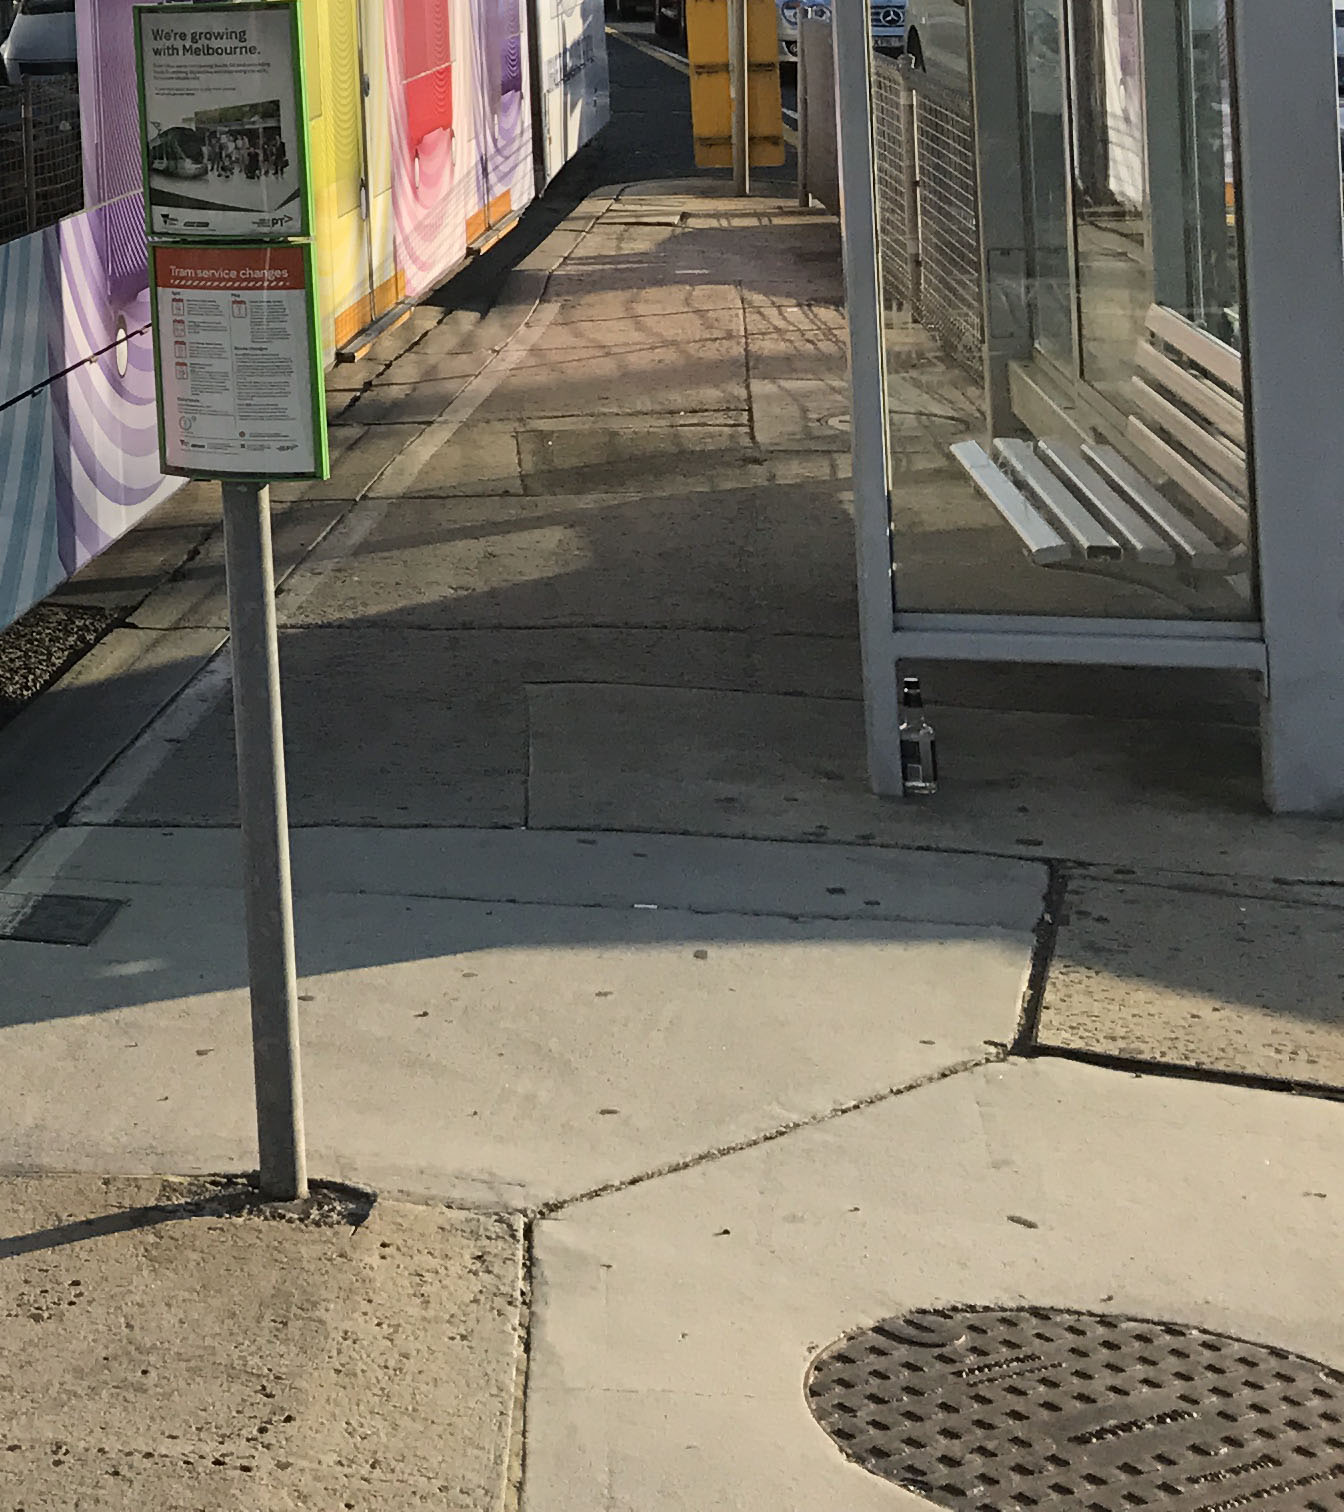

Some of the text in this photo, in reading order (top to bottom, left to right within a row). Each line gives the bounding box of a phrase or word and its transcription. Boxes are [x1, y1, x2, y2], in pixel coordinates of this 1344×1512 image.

[152, 28, 247, 44] We're growing
[153, 44, 261, 57] with Melbourne.
[170, 265, 289, 281] Tram service changes
